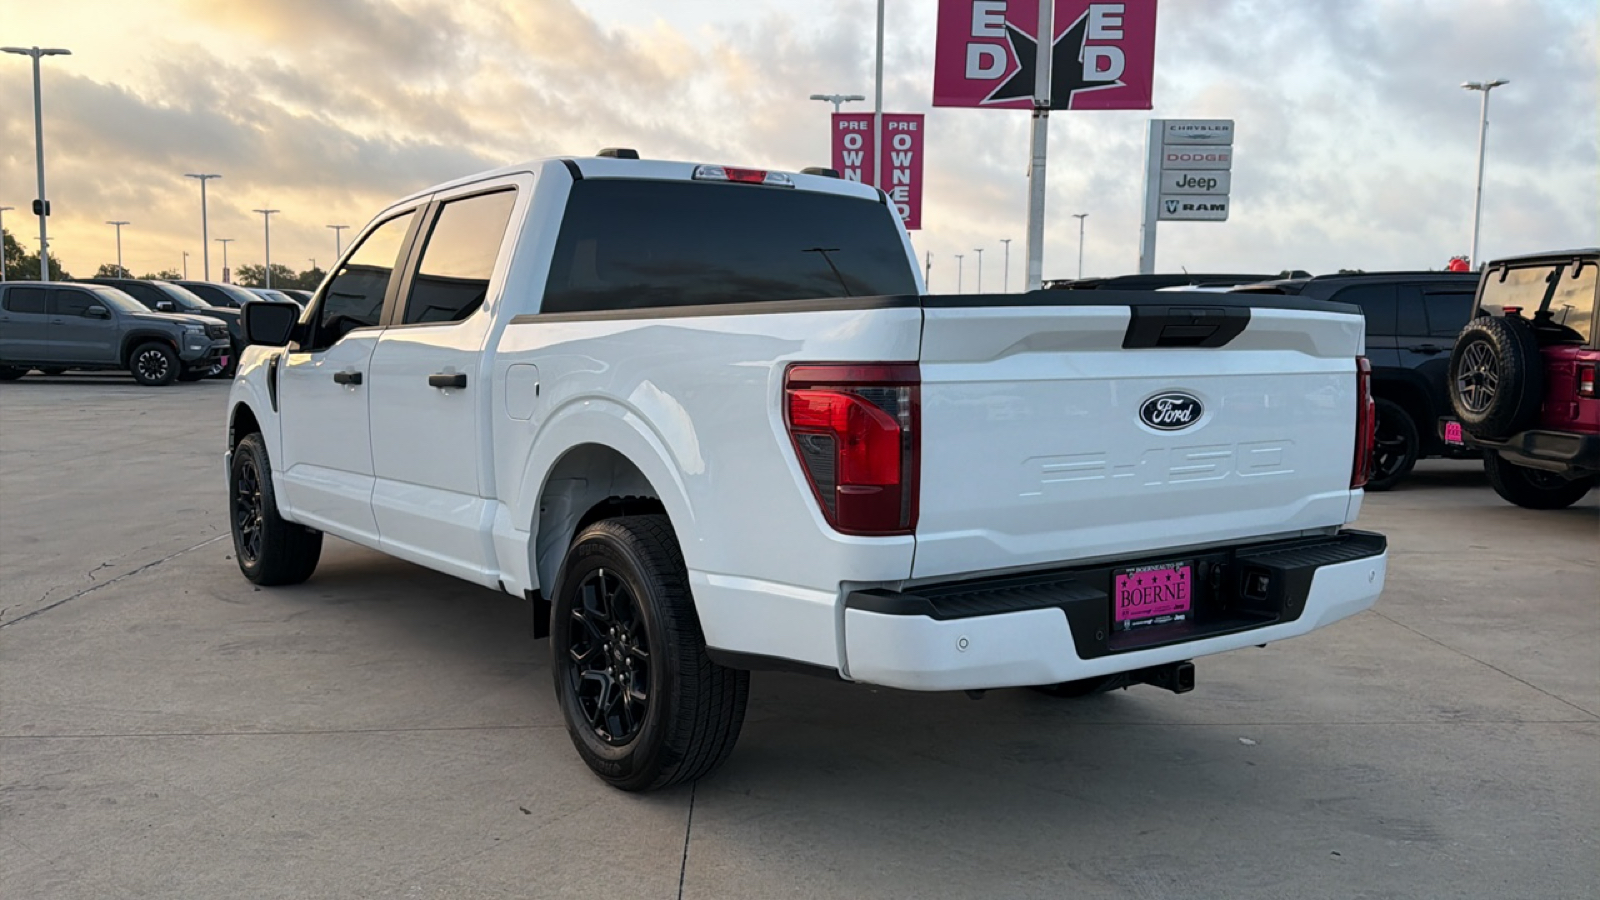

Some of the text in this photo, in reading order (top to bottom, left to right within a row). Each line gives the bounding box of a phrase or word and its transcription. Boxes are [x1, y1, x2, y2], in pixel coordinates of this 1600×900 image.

[839, 121, 868, 130] PRE
[888, 122, 917, 131] PRE
[1167, 154, 1229, 162] DODGE
[891, 134, 913, 219] OWNED
[1176, 174, 1217, 191] Jeep
[1182, 203, 1226, 211] RAM
[1152, 397, 1193, 424] Ford
[1019, 439, 1296, 497] F-150
[1120, 581, 1186, 608] BOERNE
